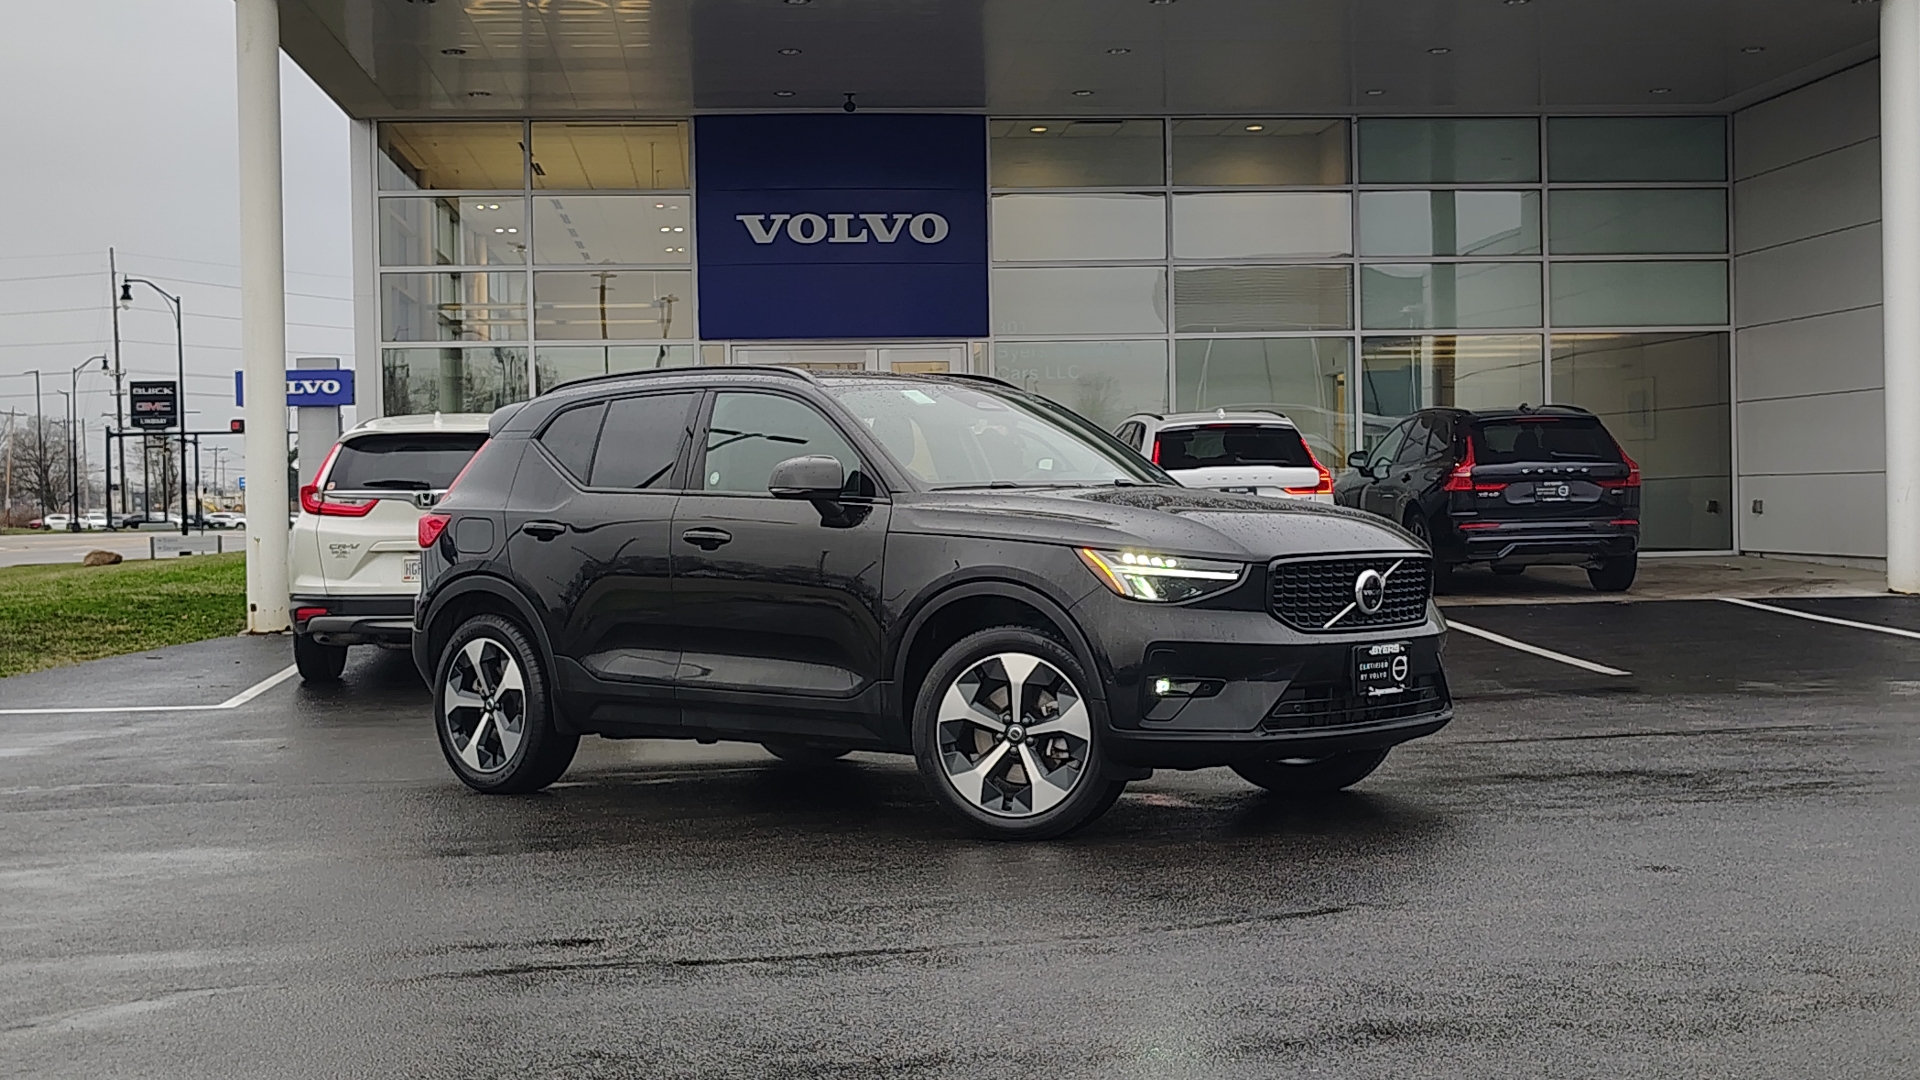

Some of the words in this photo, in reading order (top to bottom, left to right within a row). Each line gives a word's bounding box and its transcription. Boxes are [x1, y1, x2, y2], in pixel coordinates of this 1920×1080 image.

[736, 213, 949, 244] VOLVO
[999, 345, 1047, 363] Byers
[998, 365, 1039, 380] Cars
[1045, 364, 1080, 380] LLC
[132, 387, 174, 395] BUICK
[286, 380, 341, 395] LVO
[136, 401, 171, 411] GMC
